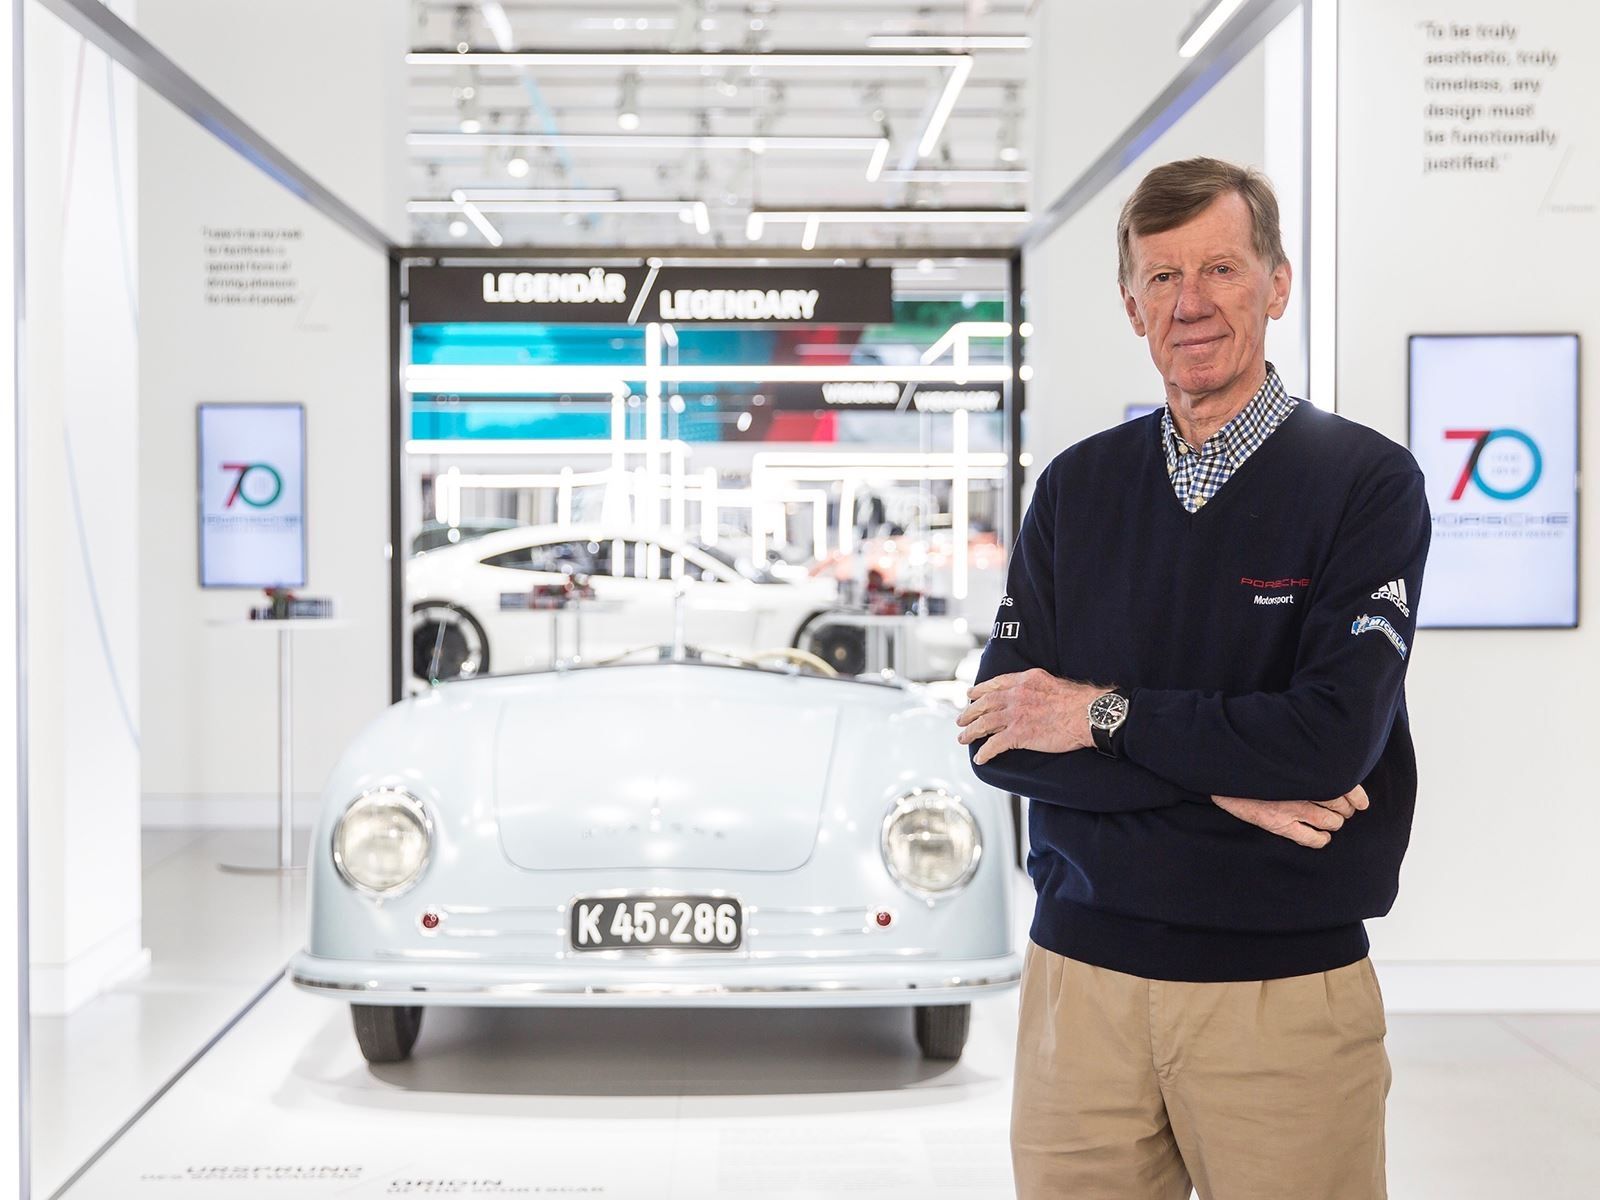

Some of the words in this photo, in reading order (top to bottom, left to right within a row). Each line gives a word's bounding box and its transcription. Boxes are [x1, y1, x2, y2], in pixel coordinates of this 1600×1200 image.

[1451, 23, 1471, 38] be
[1476, 23, 1518, 40] truly
[1516, 51, 1558, 69] truly
[1510, 80, 1541, 93] any
[1425, 103, 1482, 122] design
[1489, 105, 1535, 119] must
[1425, 129, 1445, 145] be
[483, 267, 626, 302] LEGENDÄR
[659, 289, 819, 320] LEGENDARY
[1444, 428, 1542, 501] 70
[220, 463, 283, 507] 70
[1240, 577, 1310, 588] PORSCHE
[1254, 594, 1294, 605] Motorsport
[1370, 591, 1410, 618] adidas
[578, 904, 604, 945] K
